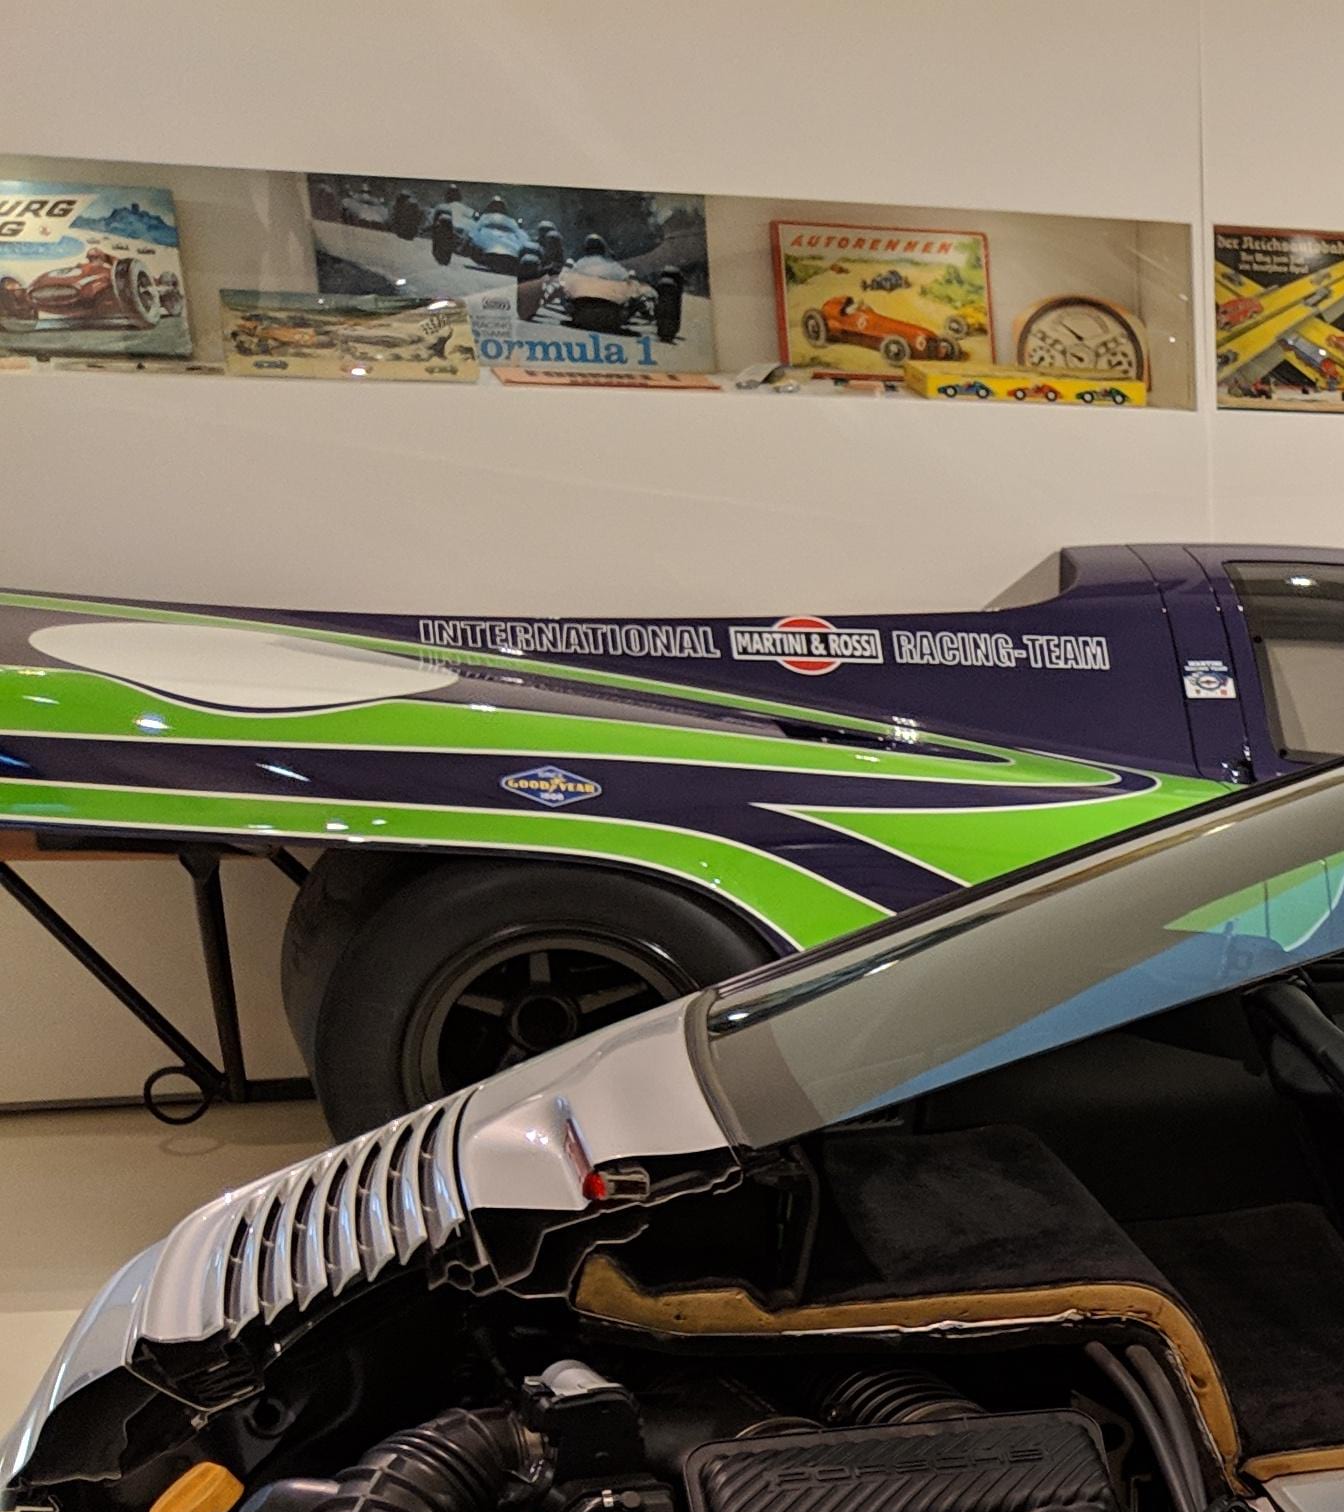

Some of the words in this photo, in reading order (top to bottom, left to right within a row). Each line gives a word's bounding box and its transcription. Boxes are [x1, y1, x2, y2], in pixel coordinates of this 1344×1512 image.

[790, 234, 953, 254] AUTORENNEN
[473, 332, 628, 366] ormula
[637, 335, 657, 366] 1
[418, 618, 722, 660] INTERNATIONAL
[736, 630, 809, 656] MARTINI
[809, 632, 829, 656] &
[830, 633, 878, 658] ROSSI
[891, 630, 1111, 670] RACING-TEAM
